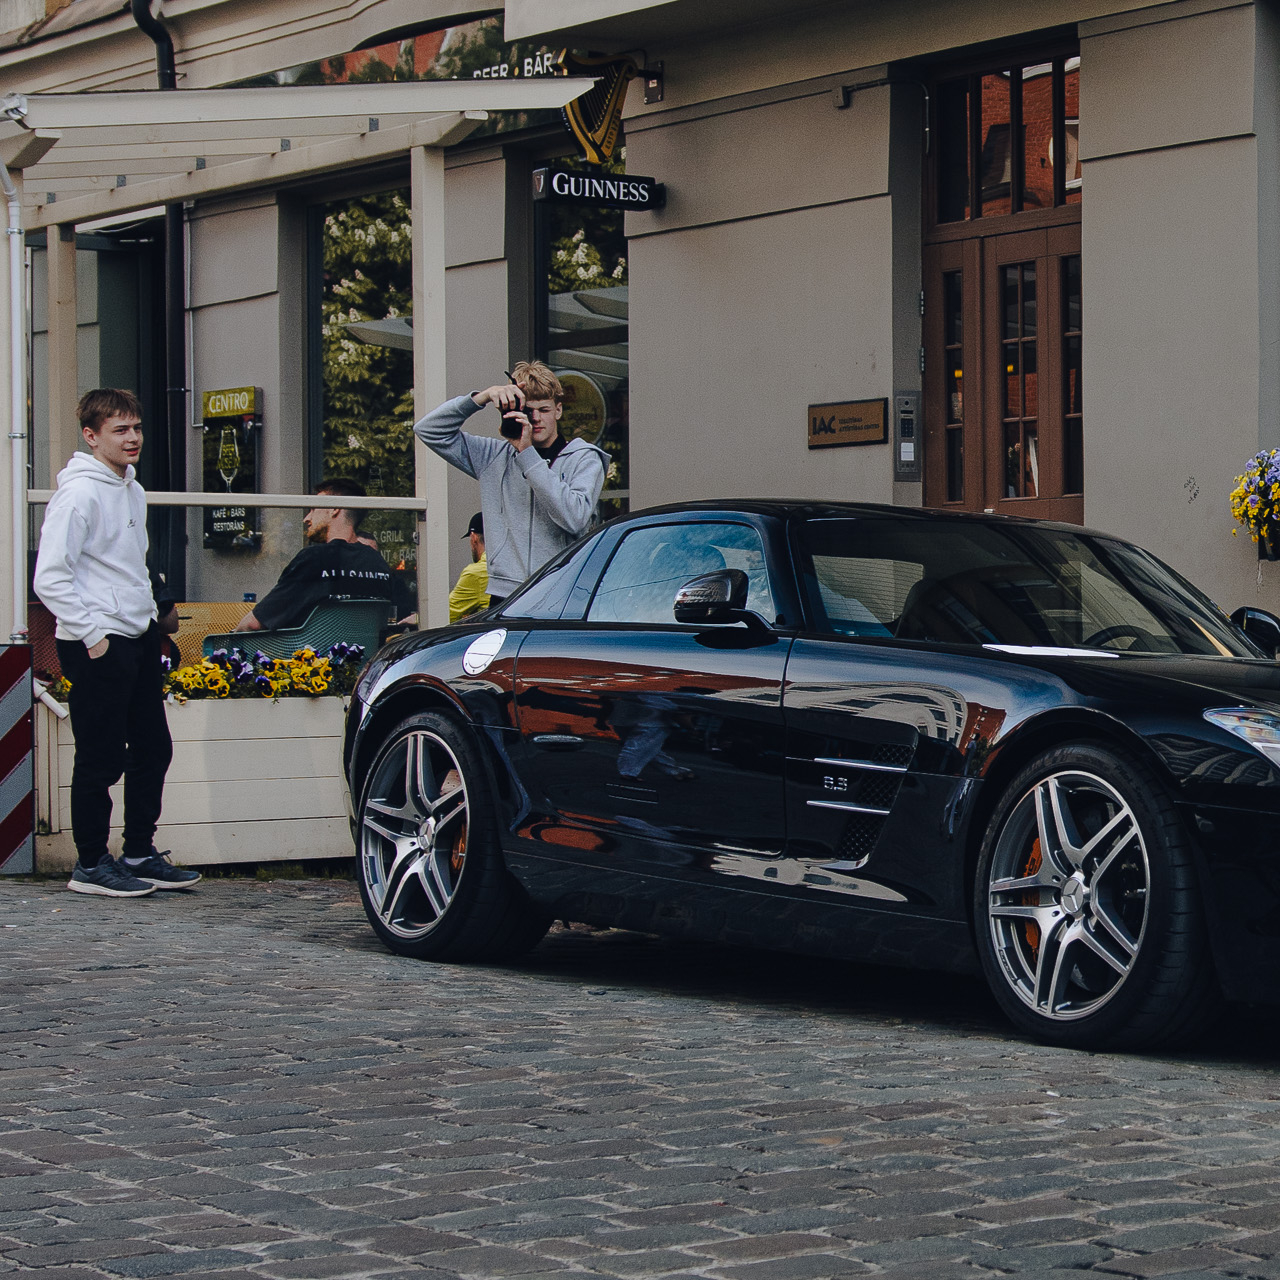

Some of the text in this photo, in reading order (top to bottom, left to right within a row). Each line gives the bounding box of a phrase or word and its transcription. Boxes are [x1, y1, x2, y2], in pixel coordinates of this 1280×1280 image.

[553, 172, 649, 202] GUINNESS
[209, 392, 249, 413] CENTRO
[813, 416, 837, 435] IAC
[381, 531, 404, 543] GRILL
